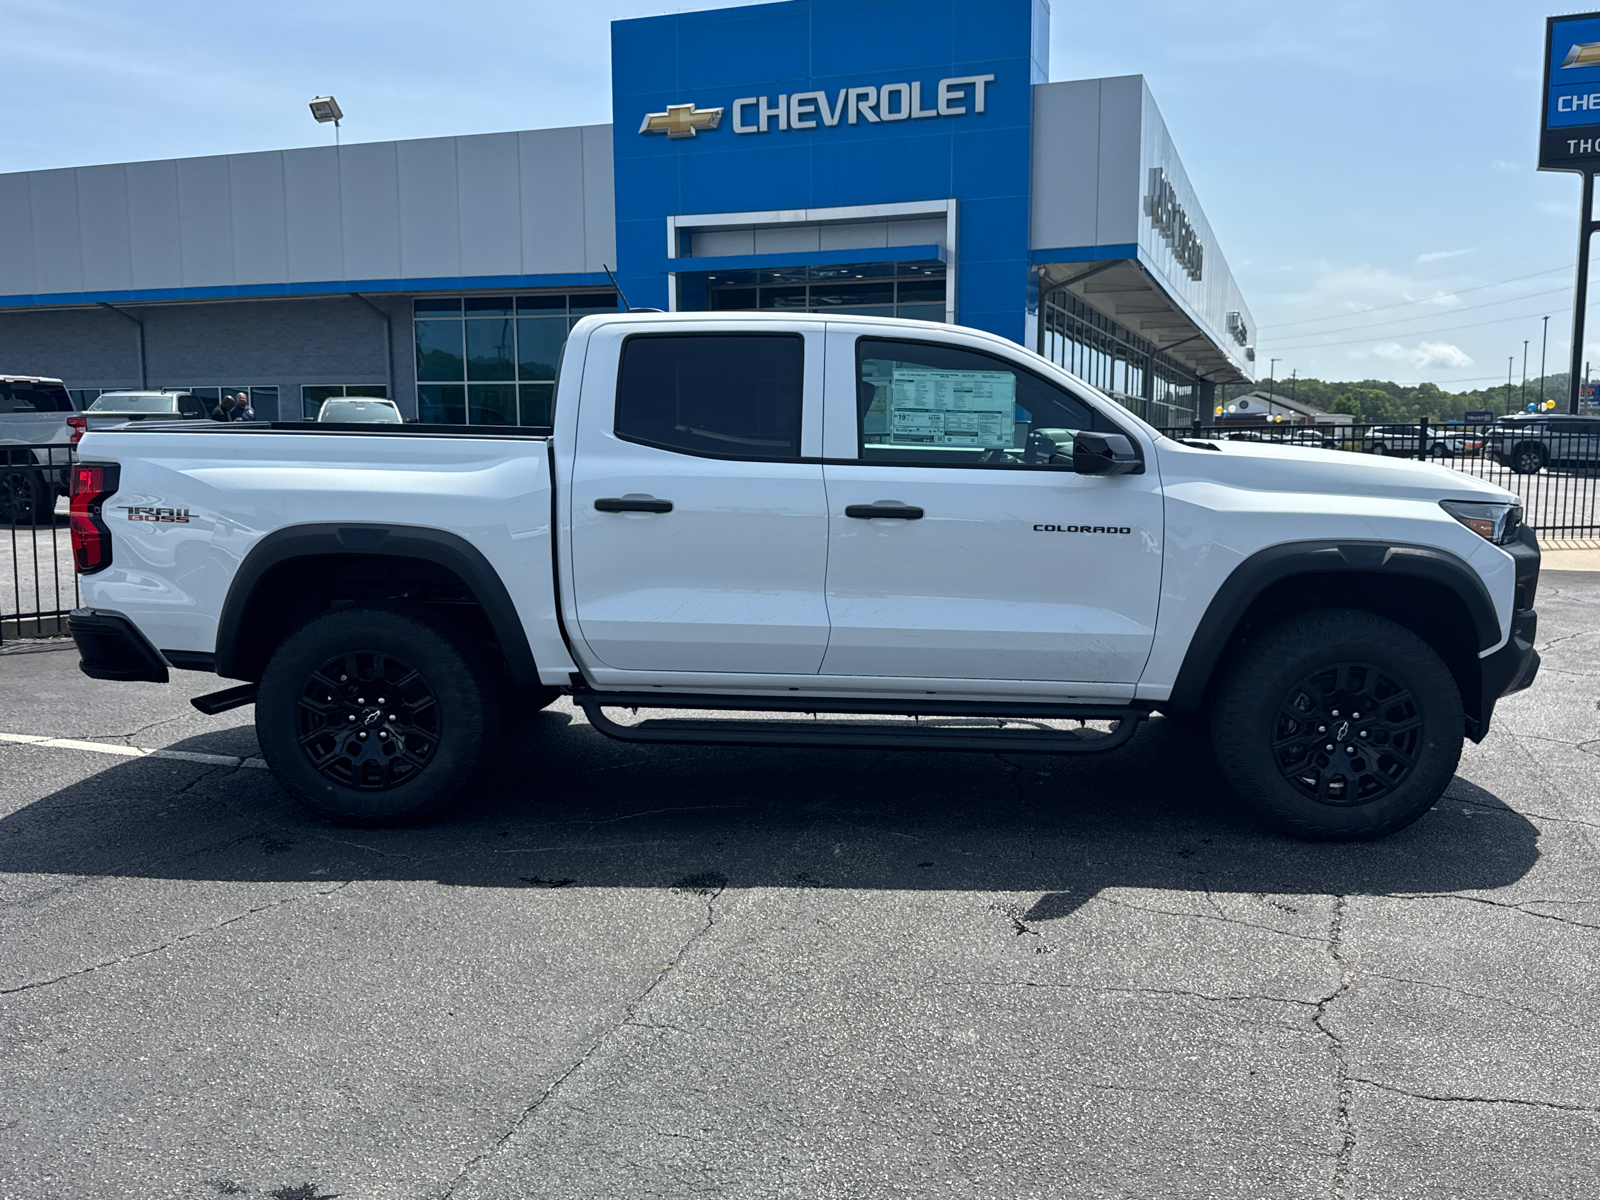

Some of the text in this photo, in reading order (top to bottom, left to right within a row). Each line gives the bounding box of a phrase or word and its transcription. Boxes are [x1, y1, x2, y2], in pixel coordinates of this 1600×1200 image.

[732, 73, 995, 134] CHEVROLET
[1557, 93, 1600, 112] CHE
[117, 506, 199, 518] TRAIL
[128, 515, 189, 523] BOSS
[1033, 524, 1131, 534] COLORADO
